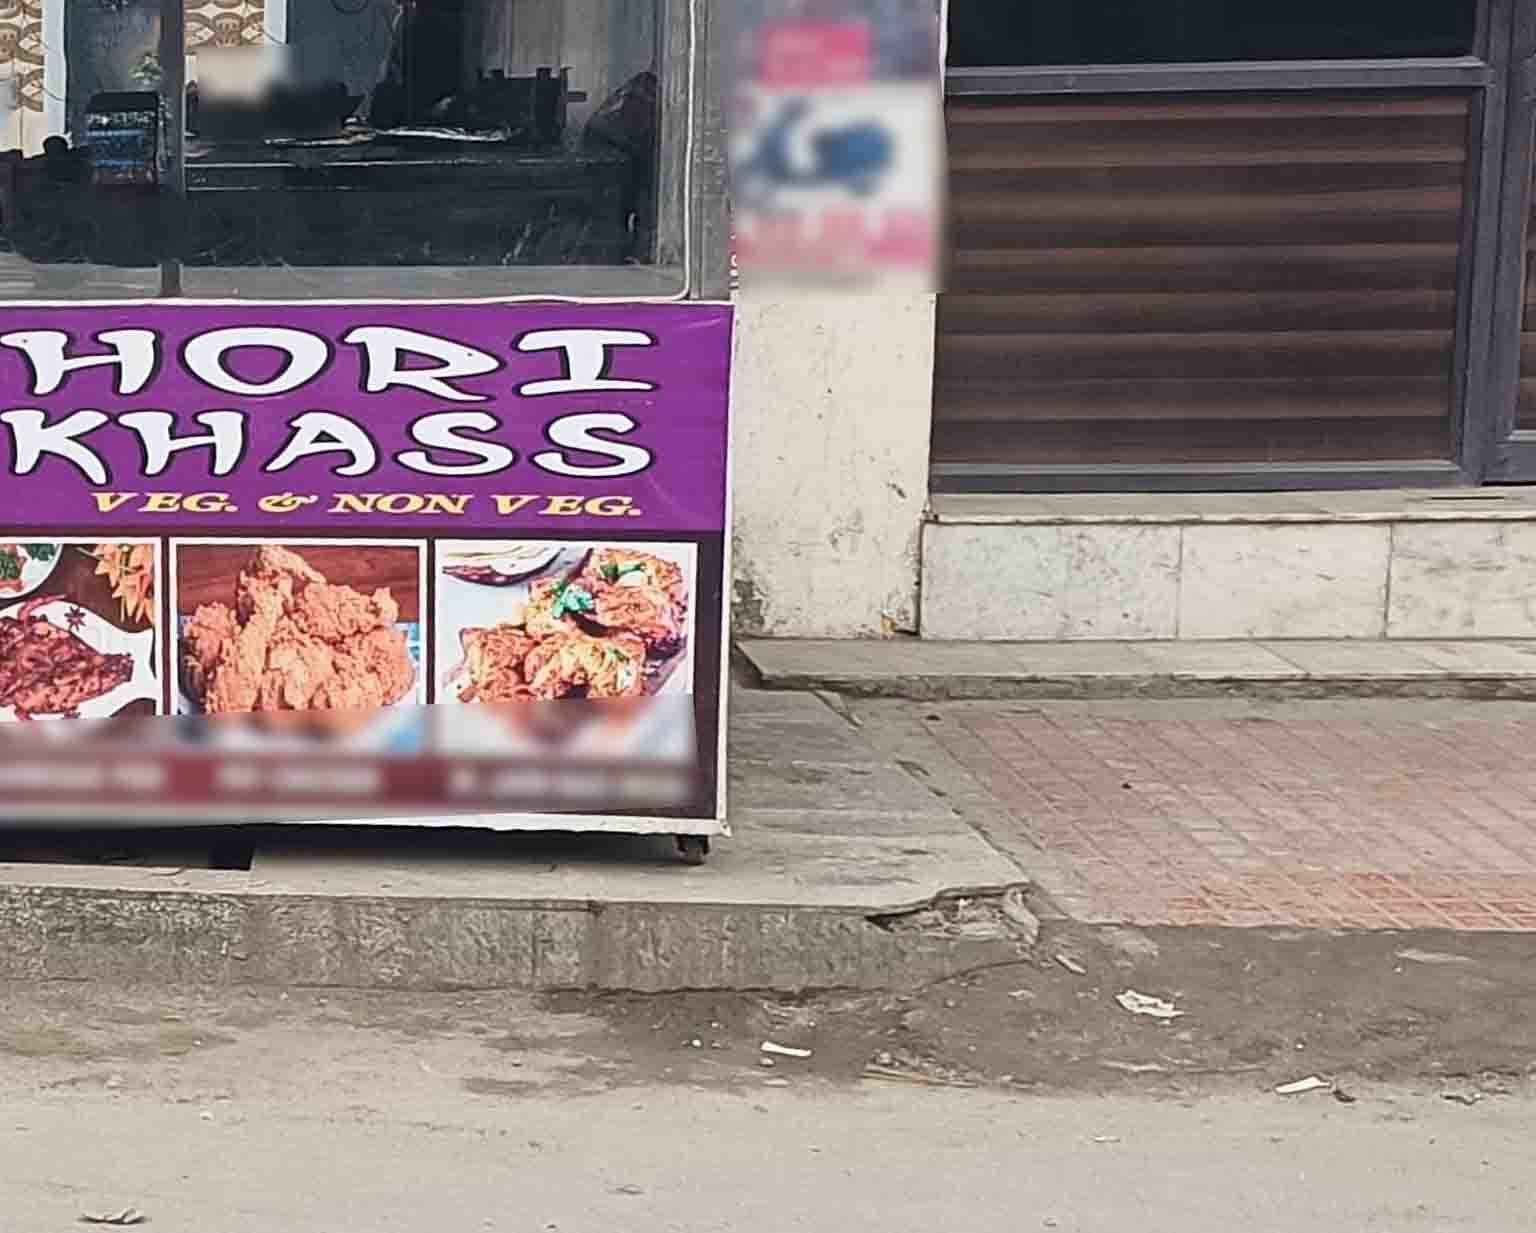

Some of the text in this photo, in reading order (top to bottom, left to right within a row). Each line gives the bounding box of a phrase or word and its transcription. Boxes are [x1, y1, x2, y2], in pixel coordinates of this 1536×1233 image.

[0, 409, 652, 486] KHASS
[90, 492, 641, 516] VEG. & NON VEG.
